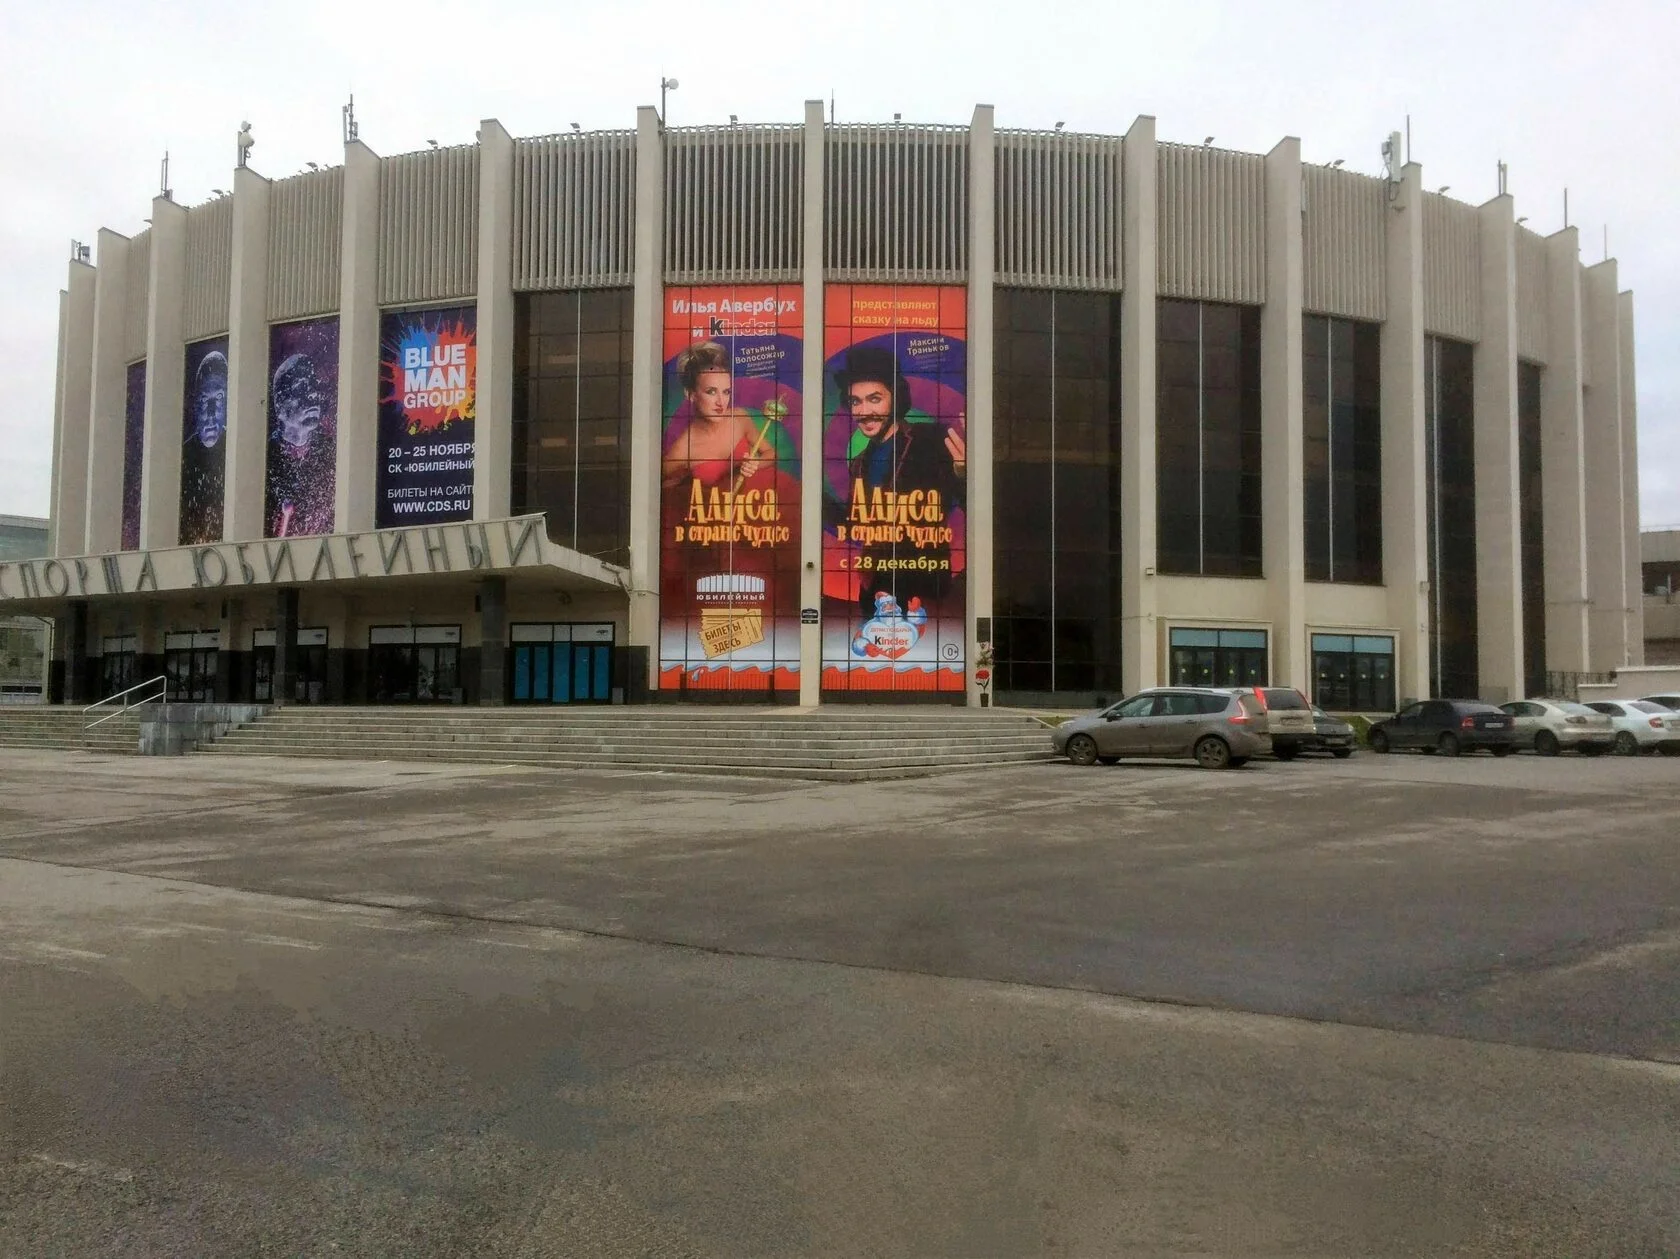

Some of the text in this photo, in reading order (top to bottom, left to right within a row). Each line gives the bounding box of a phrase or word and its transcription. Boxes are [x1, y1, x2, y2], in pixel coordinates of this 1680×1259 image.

[672, 296, 796, 316] Илья Авербух
[852, 299, 937, 311] представляют
[852, 316, 939, 327] сказку на льду
[692, 325, 704, 337] и
[740, 344, 775, 355] Татьяна
[906, 343, 950, 356] Траньков
[909, 337, 945, 347] Максим
[404, 343, 467, 369] BLUE
[404, 365, 466, 393] MAN
[403, 389, 466, 409] GROUP
[388, 447, 402, 459] 20
[413, 446, 427, 457] 25
[388, 463, 402, 474] СК
[387, 484, 474, 499] БИЛЕТЫ НА САЙТ
[393, 500, 471, 514] WWW.CDS.RU
[684, 478, 781, 525] Алиса
[846, 477, 944, 525] Алиса
[675, 525, 790, 548] в стране чудес
[837, 525, 953, 549] в стране чудес
[191, 518, 544, 588] ЮБИЛЕЙНЫЙ
[840, 556, 949, 571] с 28 декабря
[696, 593, 765, 601] ЮБИЛЕЙНЫЙ
[704, 622, 742, 641] БИЛЕТЫ
[713, 638, 742, 654] ЗДЕСЬ
[874, 635, 909, 646] Kinder
[947, 647, 958, 656] 0+
